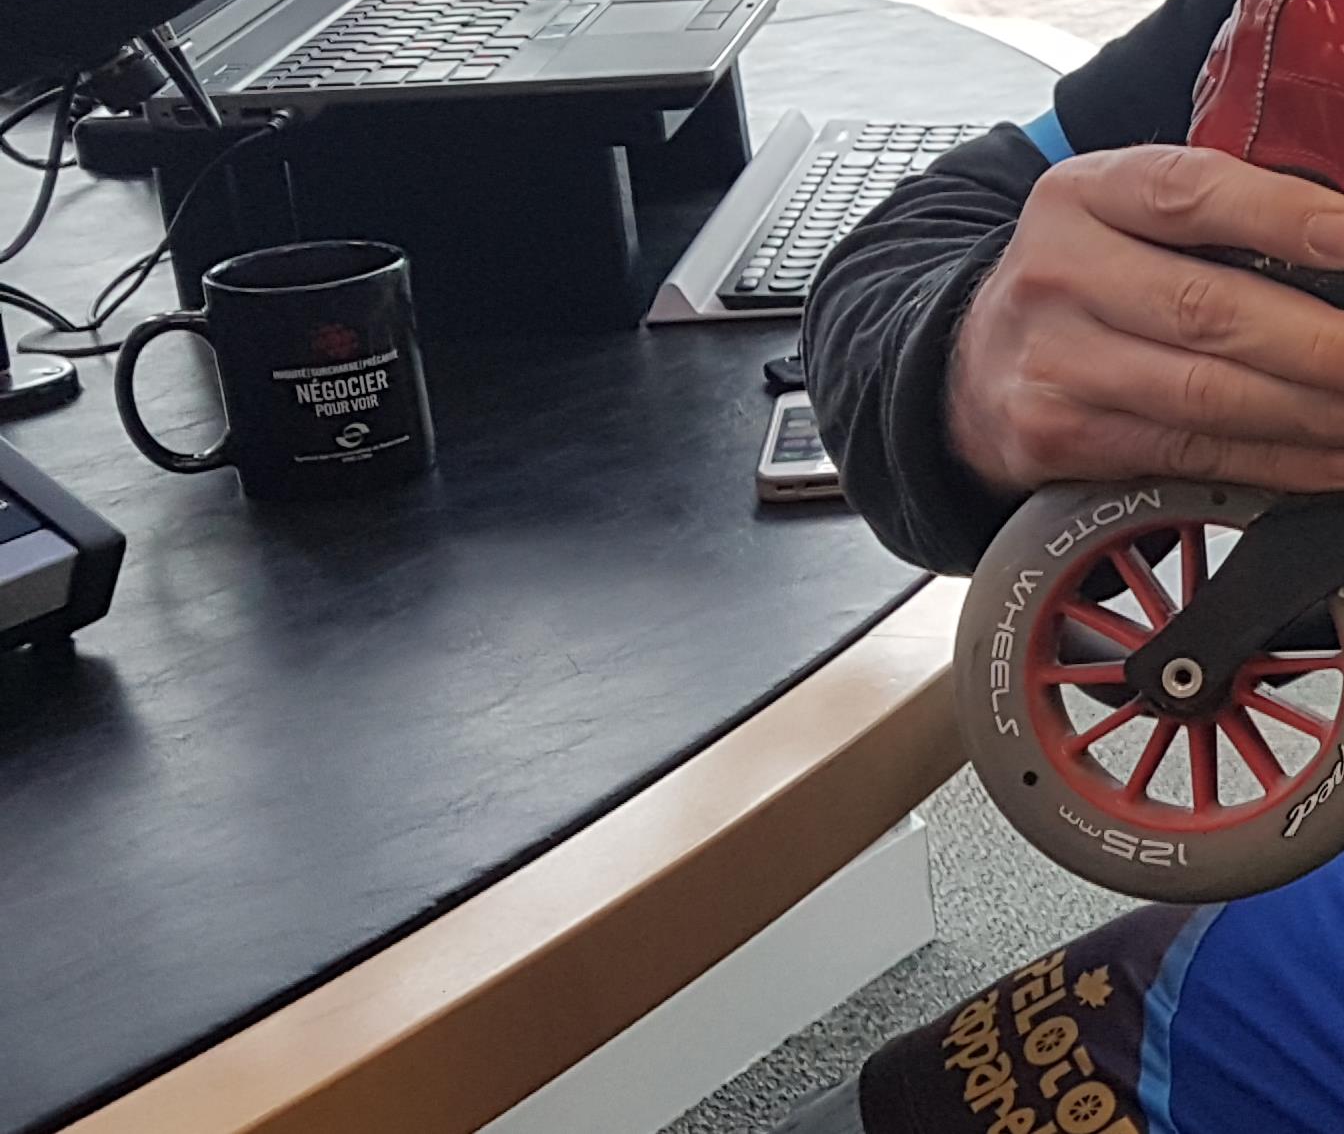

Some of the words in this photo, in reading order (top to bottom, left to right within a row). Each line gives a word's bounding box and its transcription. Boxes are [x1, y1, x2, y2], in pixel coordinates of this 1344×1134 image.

[296, 370, 389, 403] NÉGOCIER
[315, 400, 350, 417] POUR
[350, 394, 379, 412] VOIR
[989, 569, 1044, 739] WHEELS
[1058, 804, 1188, 868] 125mm
